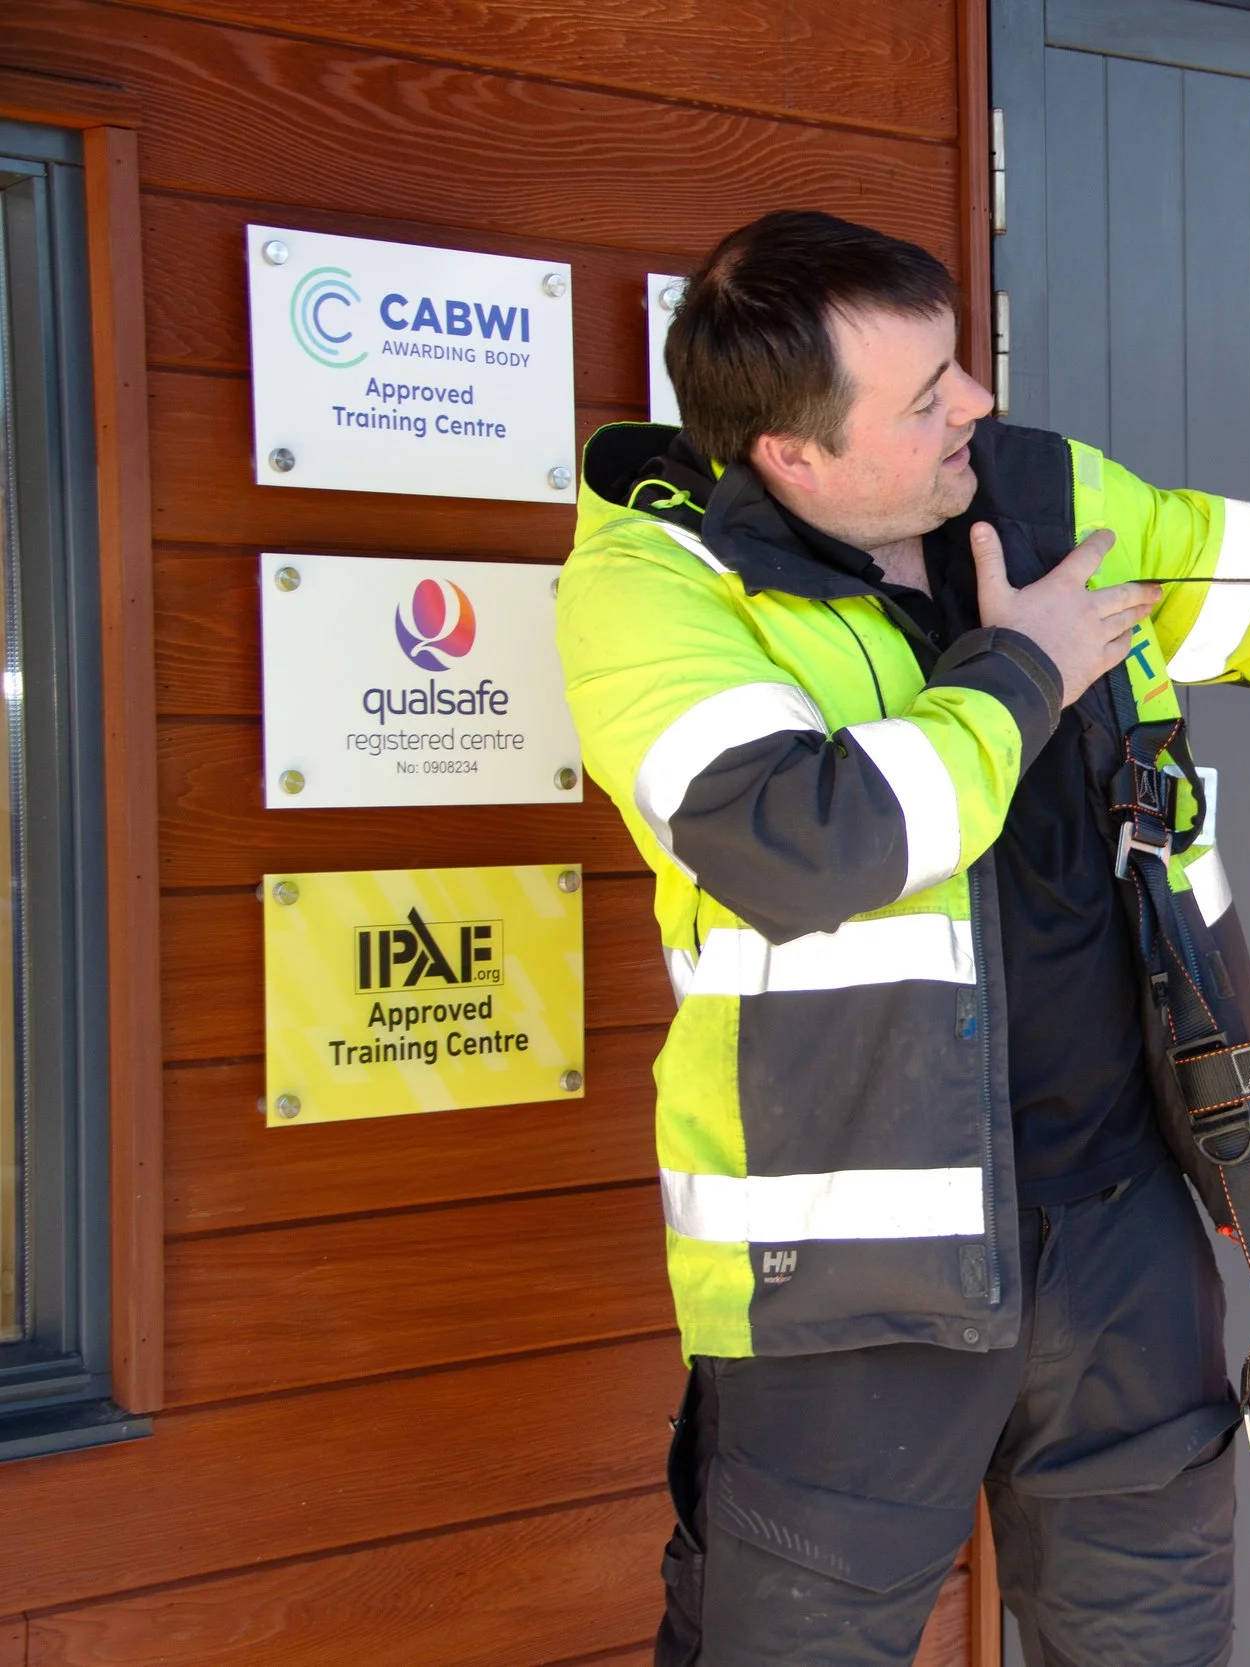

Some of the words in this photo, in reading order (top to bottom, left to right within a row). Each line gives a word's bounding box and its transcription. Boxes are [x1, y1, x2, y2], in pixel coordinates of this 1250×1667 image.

[380, 293, 530, 342] CABWI
[381, 340, 476, 363] AWARDING
[485, 350, 531, 368] BODY
[365, 376, 474, 405] Approved
[331, 405, 427, 438] Training
[435, 414, 507, 439] Centre
[362, 678, 509, 726] qualsafe
[346, 728, 455, 756] registered
[461, 730, 525, 751] centre
[396, 761, 419, 775] No:
[423, 761, 478, 774] 0908234
[358, 906, 492, 990] IPAF
[473, 968, 501, 983] .org
[367, 994, 493, 1032] Approved
[328, 1036, 438, 1065] Training
[446, 1030, 530, 1057] Centre
[763, 1250, 797, 1273] HH
